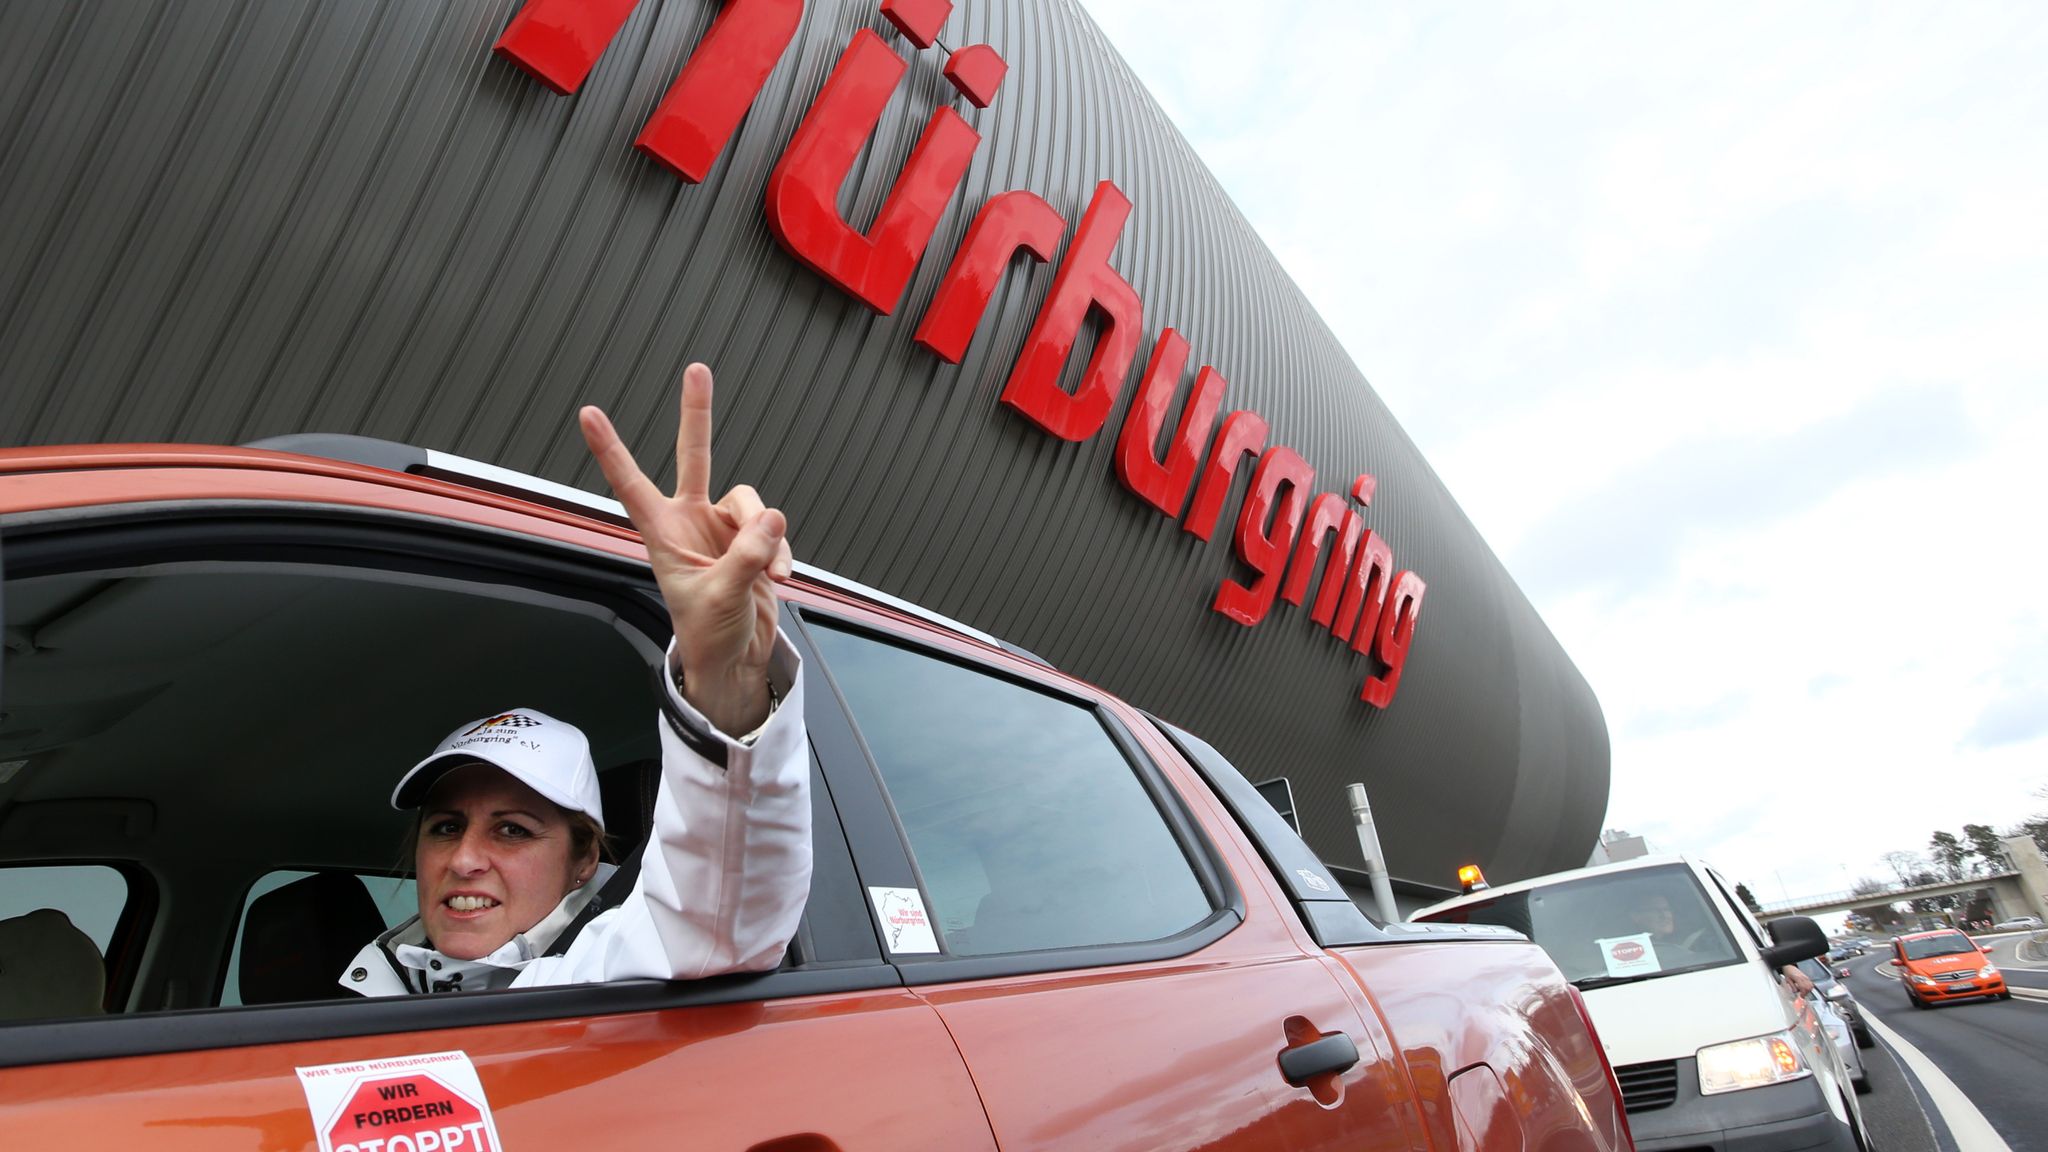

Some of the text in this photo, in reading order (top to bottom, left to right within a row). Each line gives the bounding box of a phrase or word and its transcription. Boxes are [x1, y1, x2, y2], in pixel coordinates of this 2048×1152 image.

[303, 1053, 464, 1078] WIR SIND NÜRBURGRING!
[377, 1083, 419, 1101] WIR
[353, 1101, 454, 1129] FORDERN
